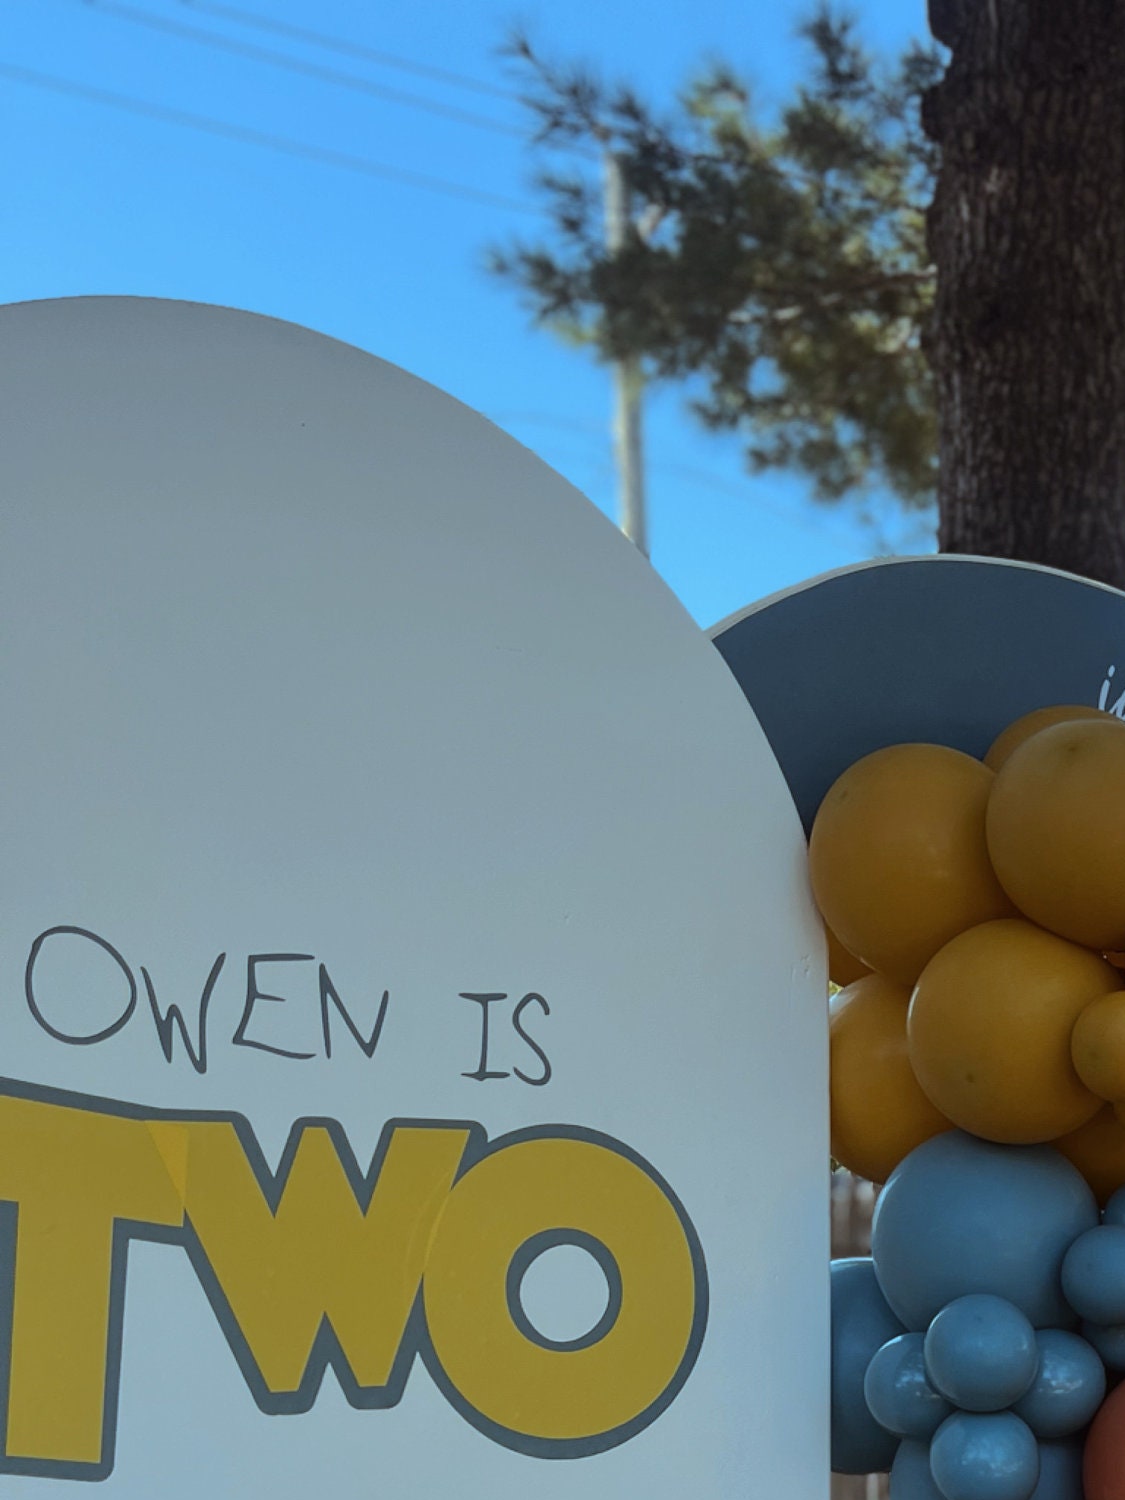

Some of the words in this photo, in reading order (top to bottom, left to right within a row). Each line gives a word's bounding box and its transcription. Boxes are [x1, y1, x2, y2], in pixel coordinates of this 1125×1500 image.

[25, 925, 389, 1074] OWEN
[459, 991, 552, 1086] IS
[0, 1076, 710, 1483] TWO
